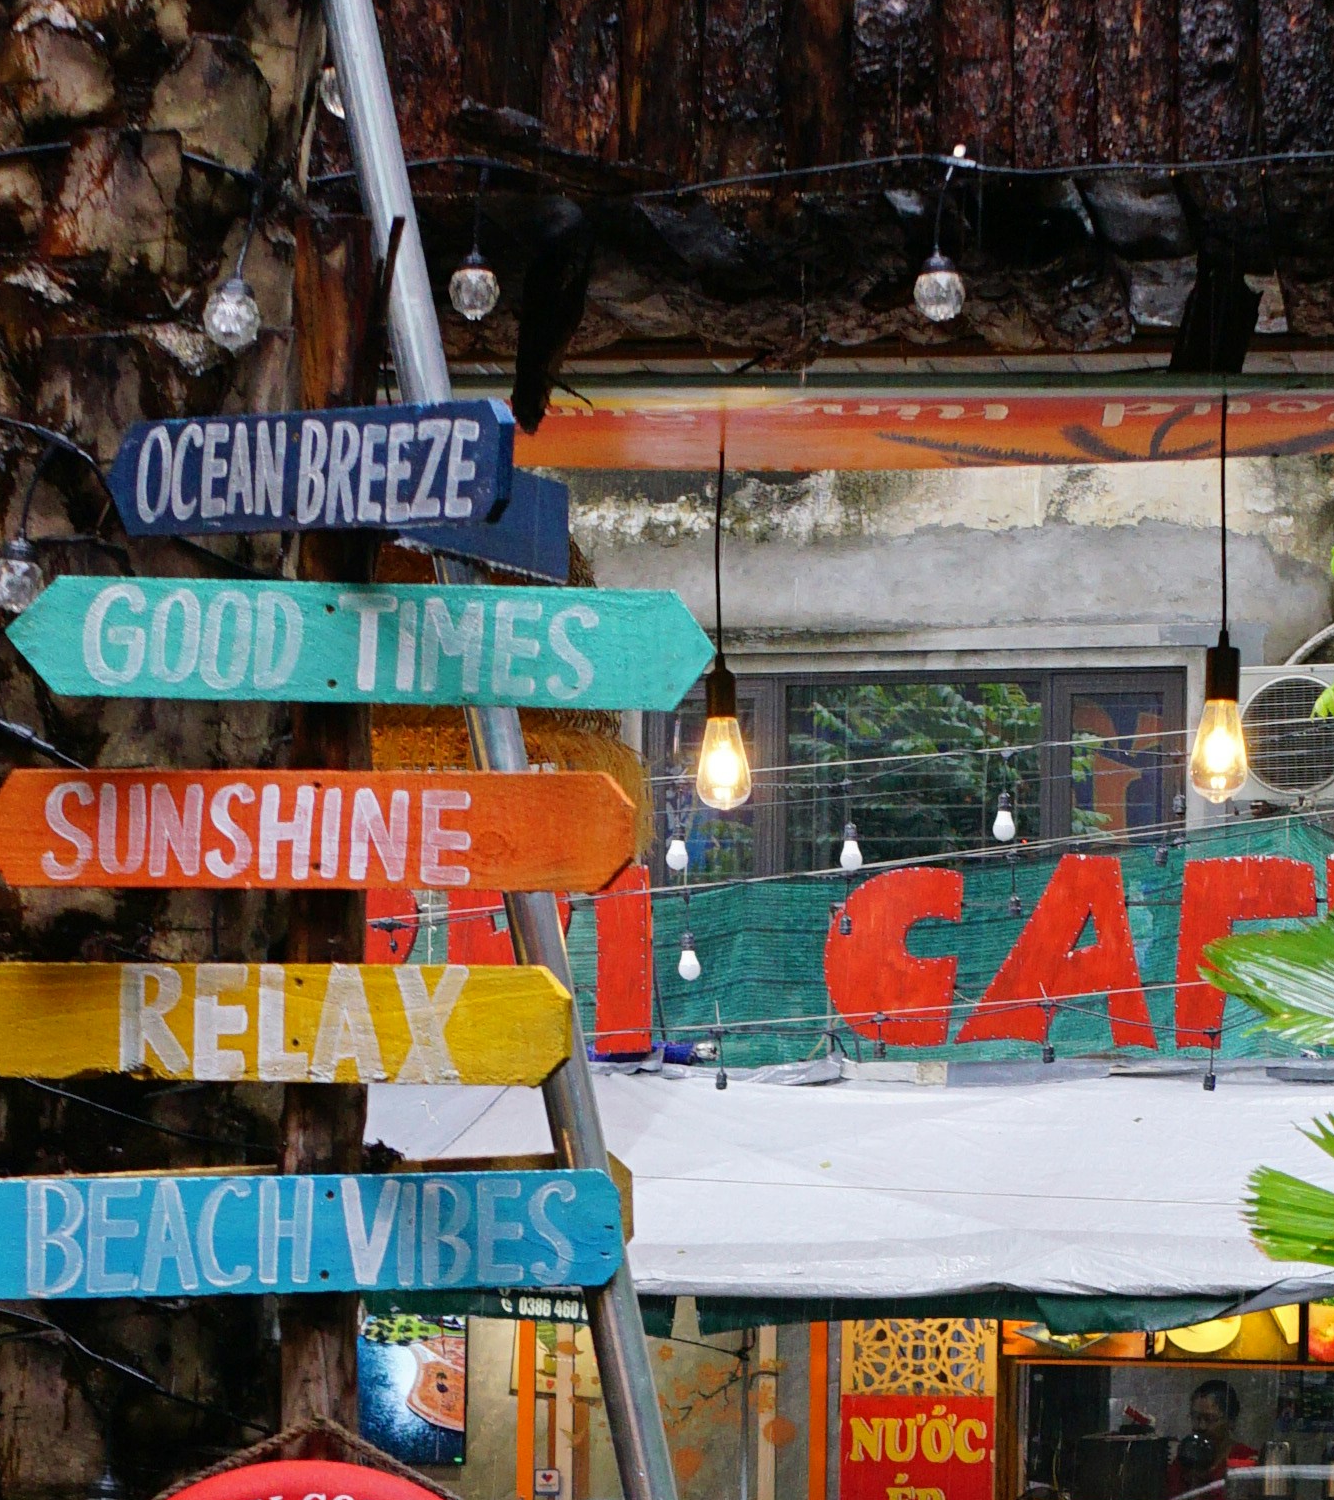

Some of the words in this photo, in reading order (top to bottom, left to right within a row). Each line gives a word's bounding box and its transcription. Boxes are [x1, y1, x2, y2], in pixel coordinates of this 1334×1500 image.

[136, 416, 286, 525] OCEAN
[298, 417, 480, 524] BREEZE
[81, 583, 304, 691] GOOD
[337, 595, 600, 700] TIMES
[41, 782, 472, 886] SUNSHINE
[119, 962, 471, 1084] RELAX
[25, 1178, 315, 1298] BEACH
[337, 1179, 578, 1293] VIBES
[518, 1296, 552, 1317] 0386
[553, 1299, 579, 1319] 460
[849, 1404, 988, 1465] NƯỚC
